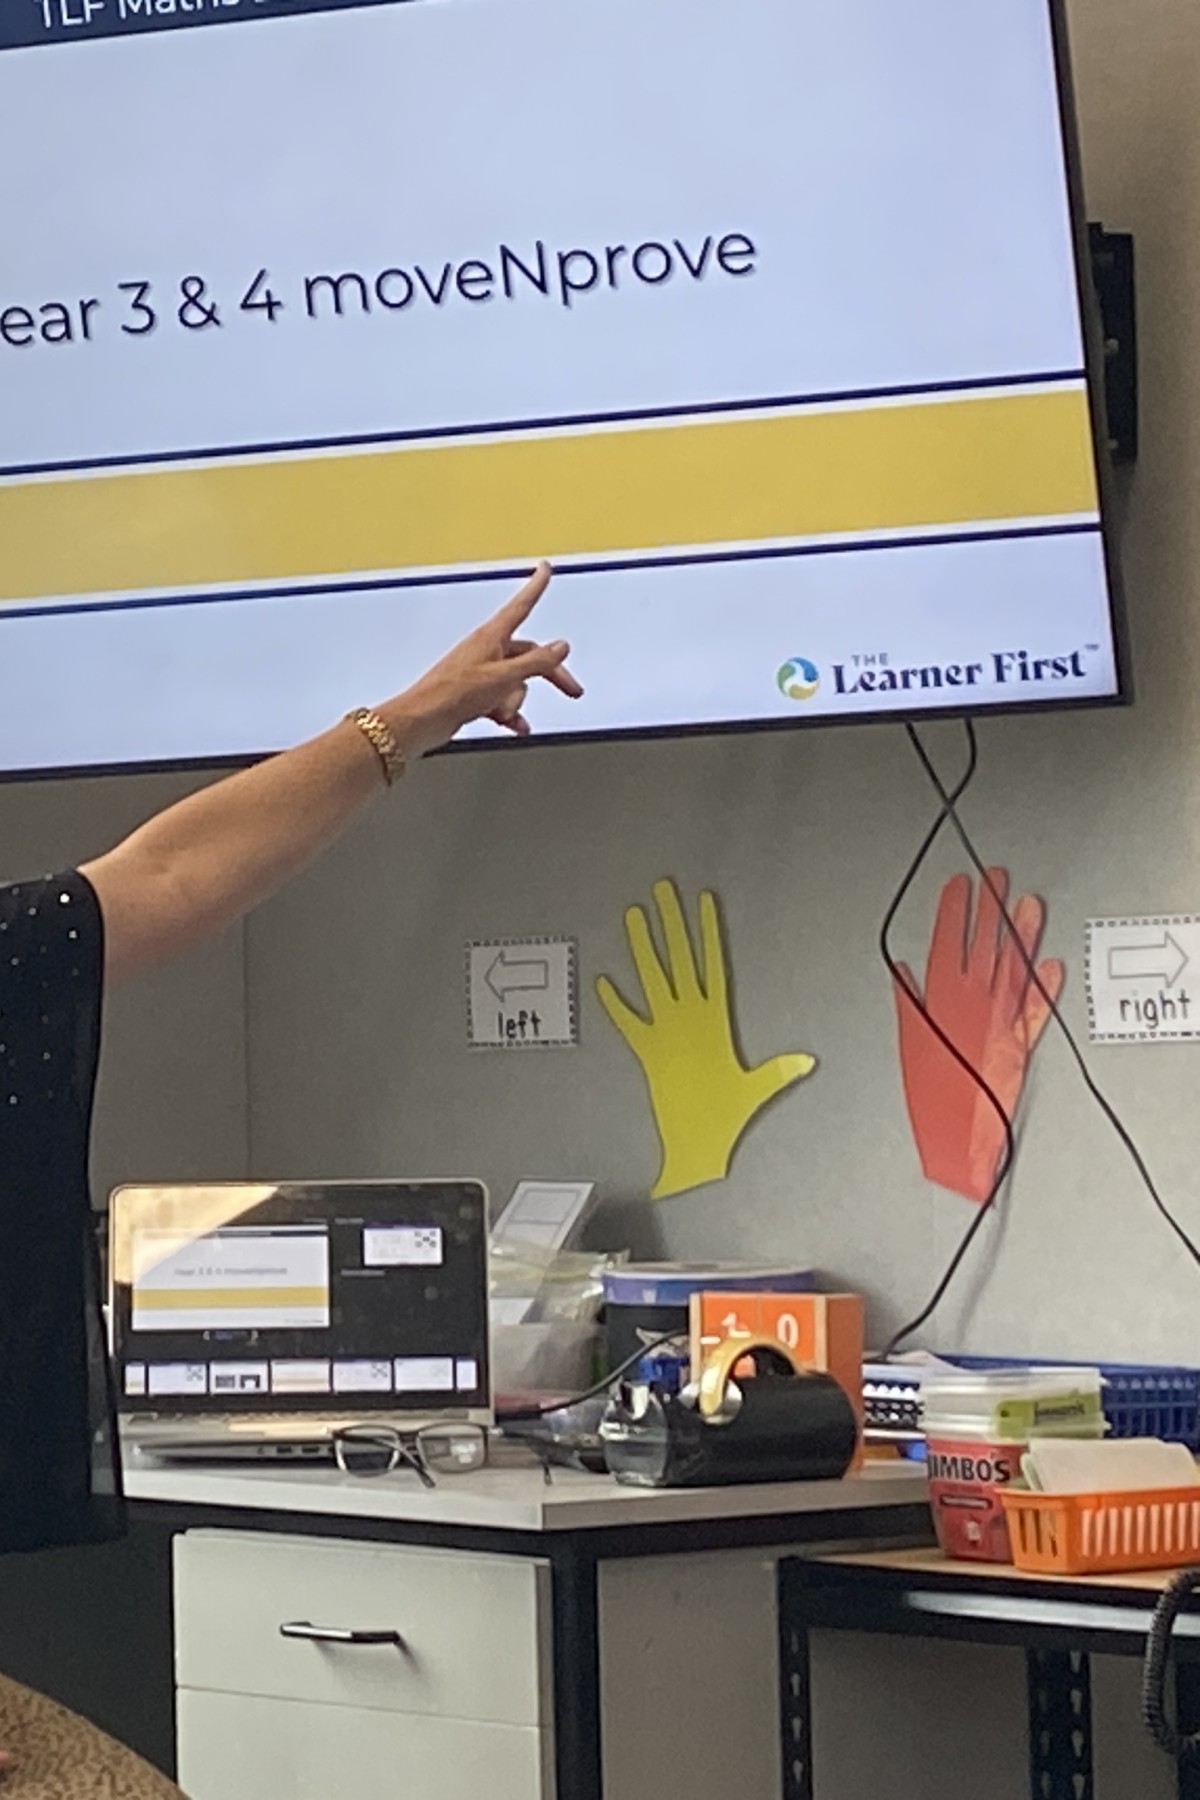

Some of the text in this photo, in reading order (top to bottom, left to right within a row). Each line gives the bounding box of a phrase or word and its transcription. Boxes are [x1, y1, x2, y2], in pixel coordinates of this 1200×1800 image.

[118, 281, 156, 335] 3
[176, 276, 222, 330] &
[240, 268, 283, 322] 4
[305, 231, 758, 318] moveNprove
[830, 650, 1087, 695] Learner First
[851, 652, 890, 667] THE
[497, 1010, 542, 1039] left
[1119, 988, 1191, 1030] right
